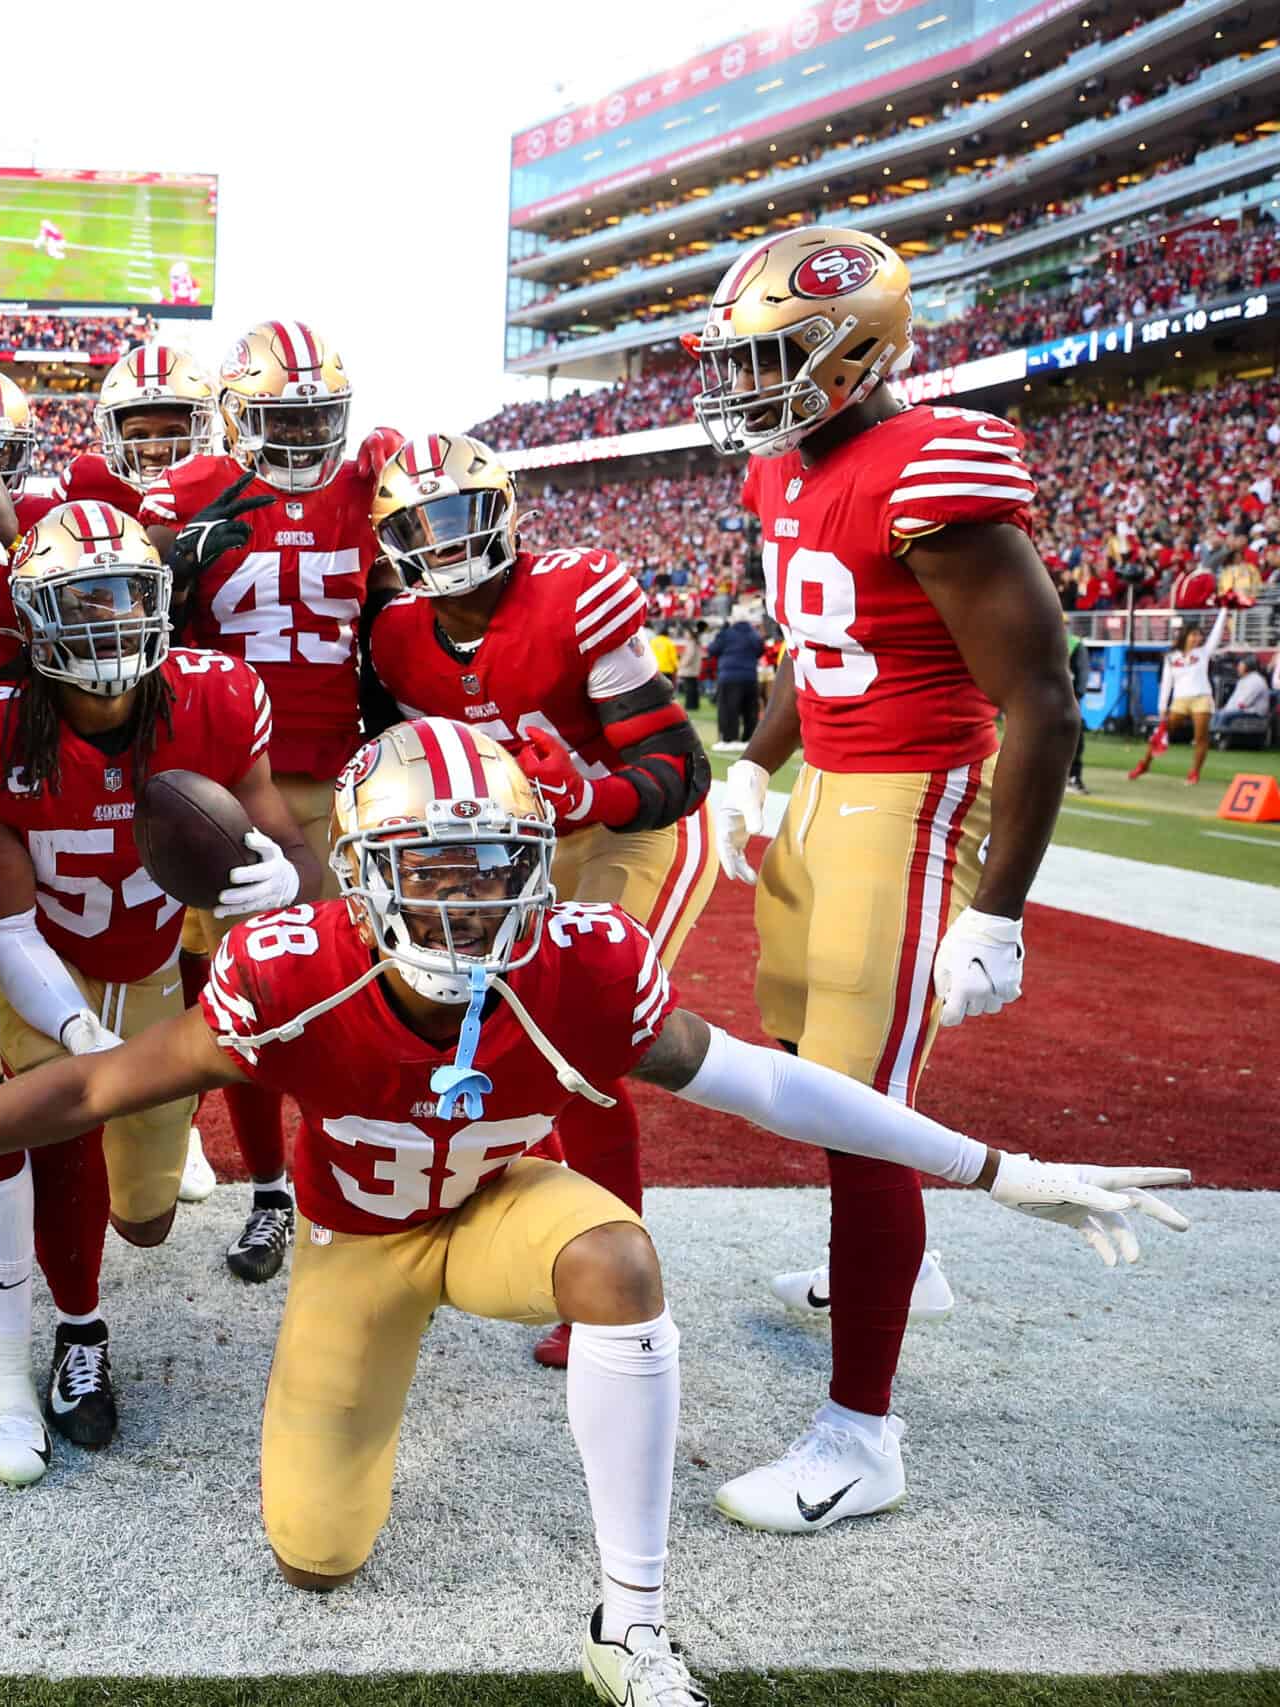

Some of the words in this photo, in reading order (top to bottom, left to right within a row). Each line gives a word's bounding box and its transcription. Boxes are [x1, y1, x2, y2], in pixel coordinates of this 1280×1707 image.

[1185, 310, 1208, 332] 10
[210, 548, 362, 665] 45
[1230, 780, 1262, 812] G
